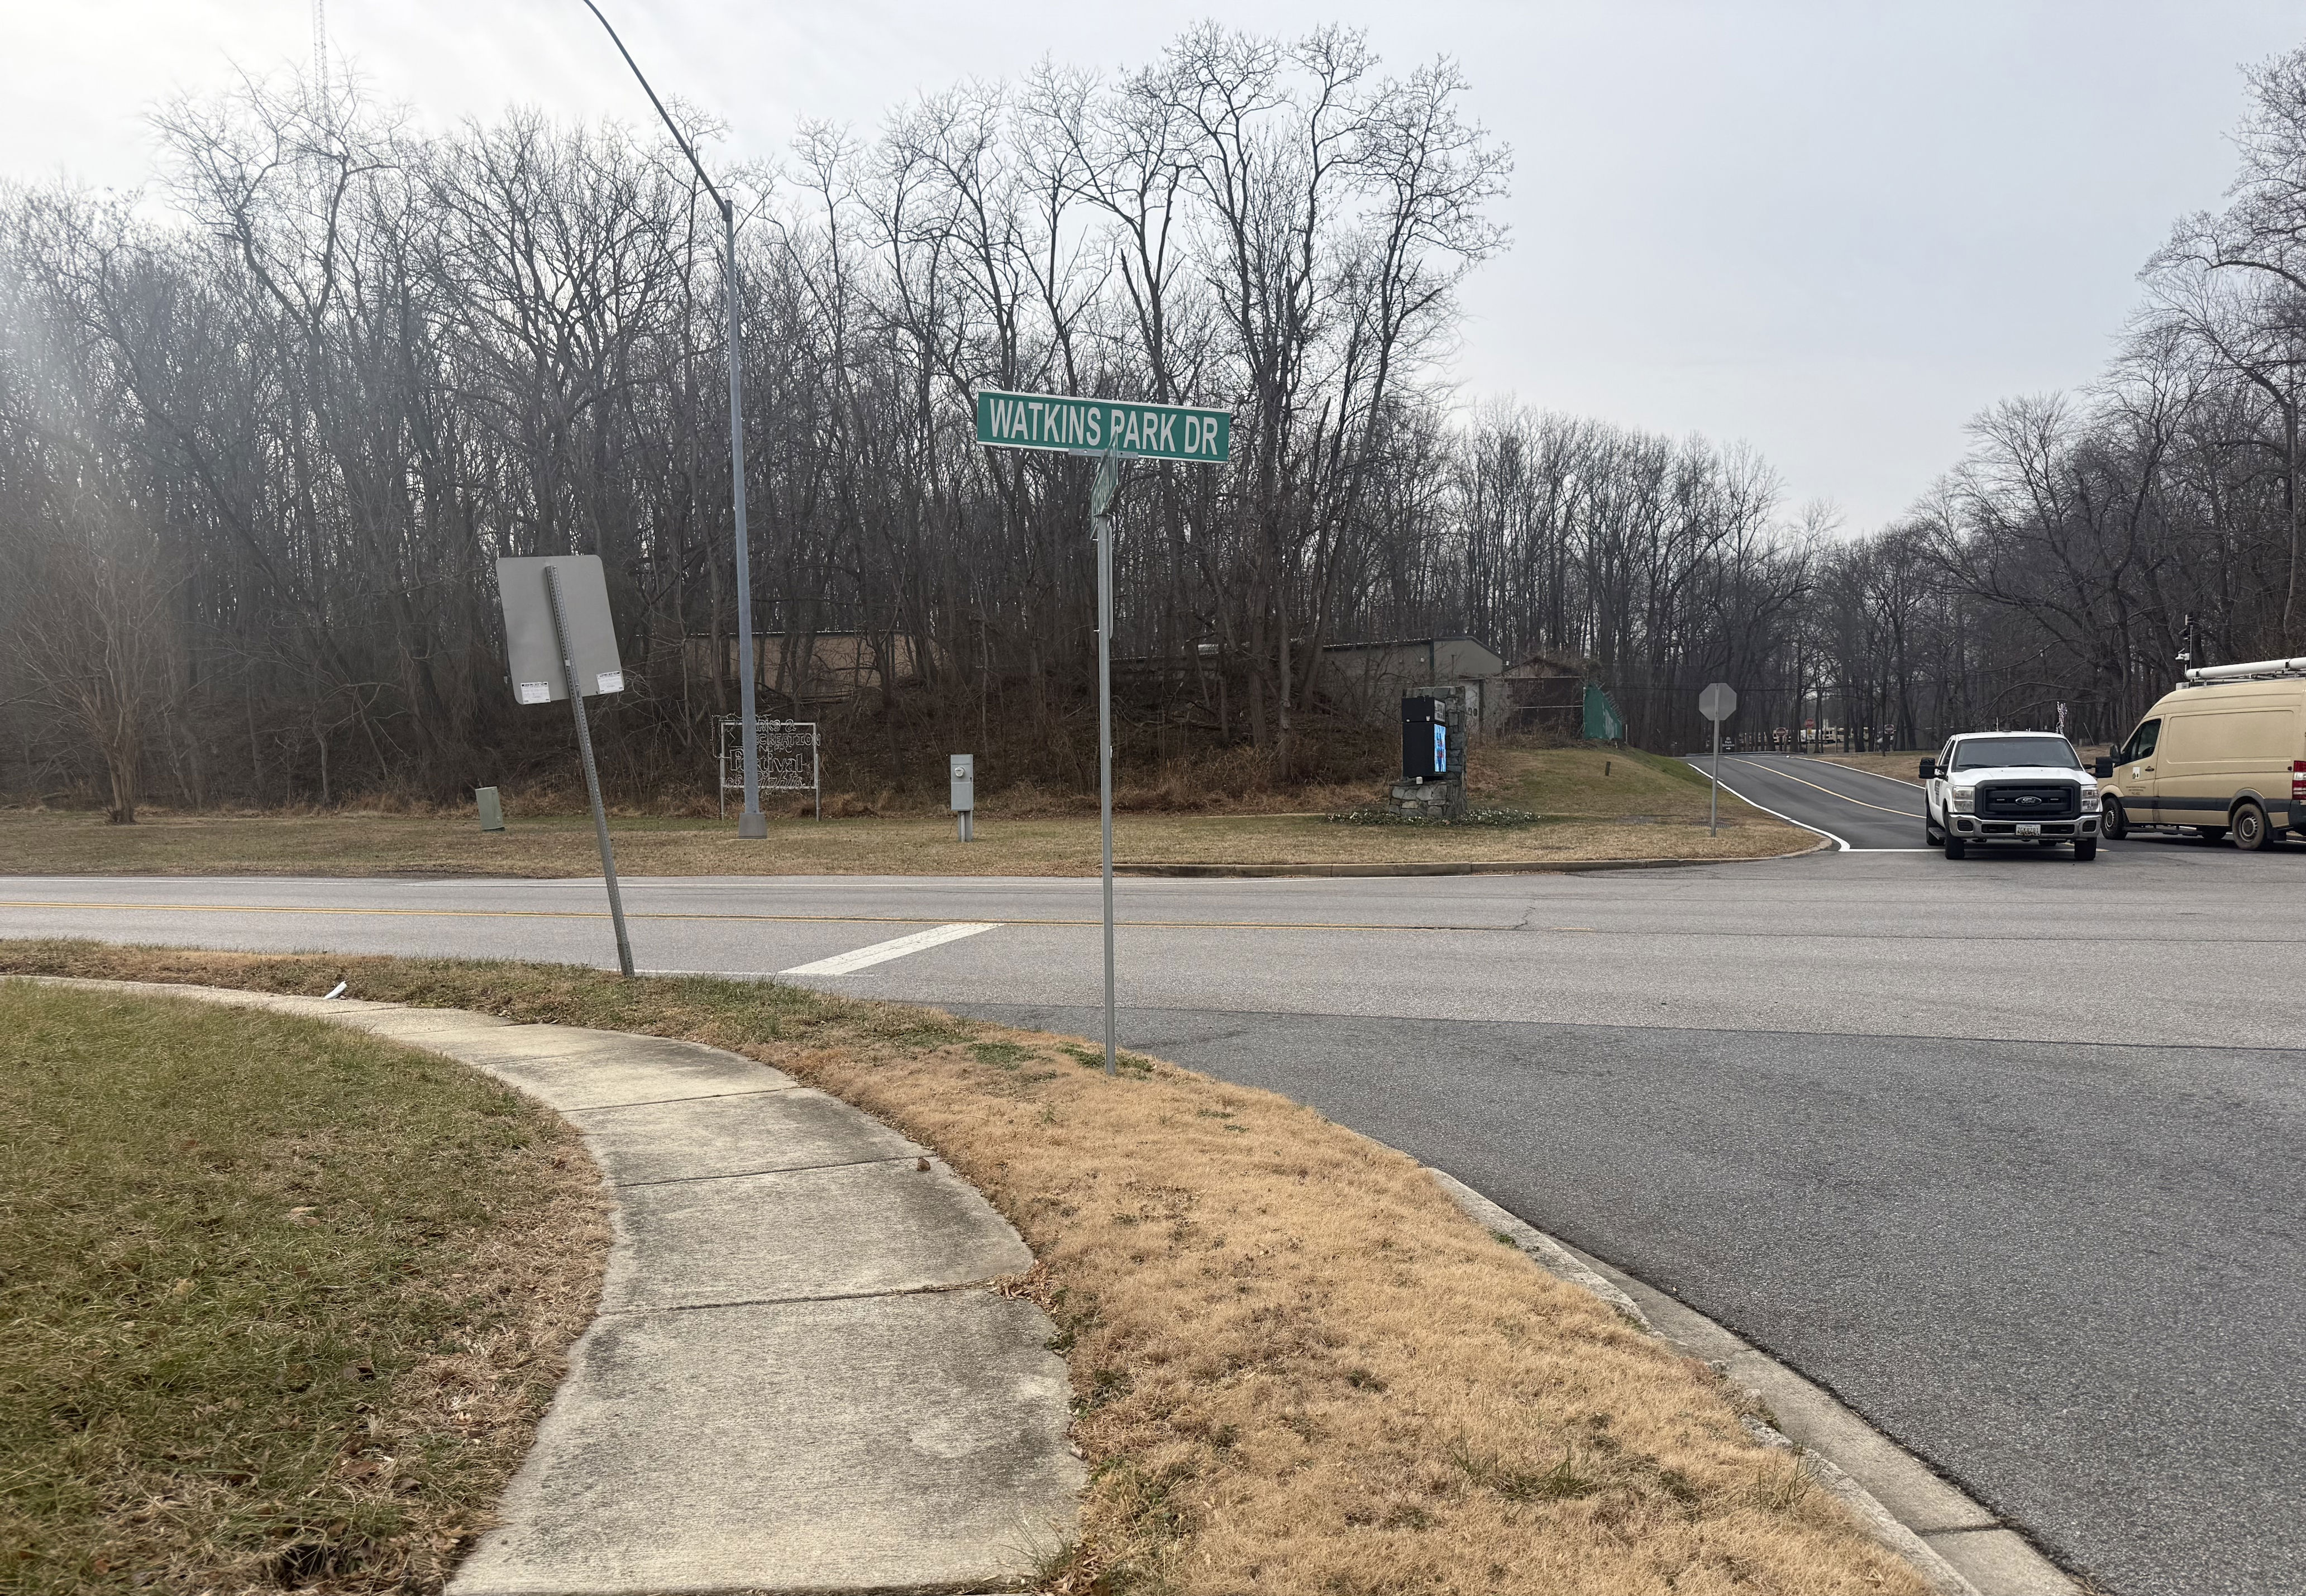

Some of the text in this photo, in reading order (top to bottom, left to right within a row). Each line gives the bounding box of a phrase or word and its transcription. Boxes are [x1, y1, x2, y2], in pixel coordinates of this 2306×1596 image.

[990, 399, 1218, 455] WATKINS PARK DR
[756, 719, 780, 732] RKS
[756, 733, 820, 746] CREATION
[730, 748, 803, 773] Ftival
[757, 771, 805, 795] ights
